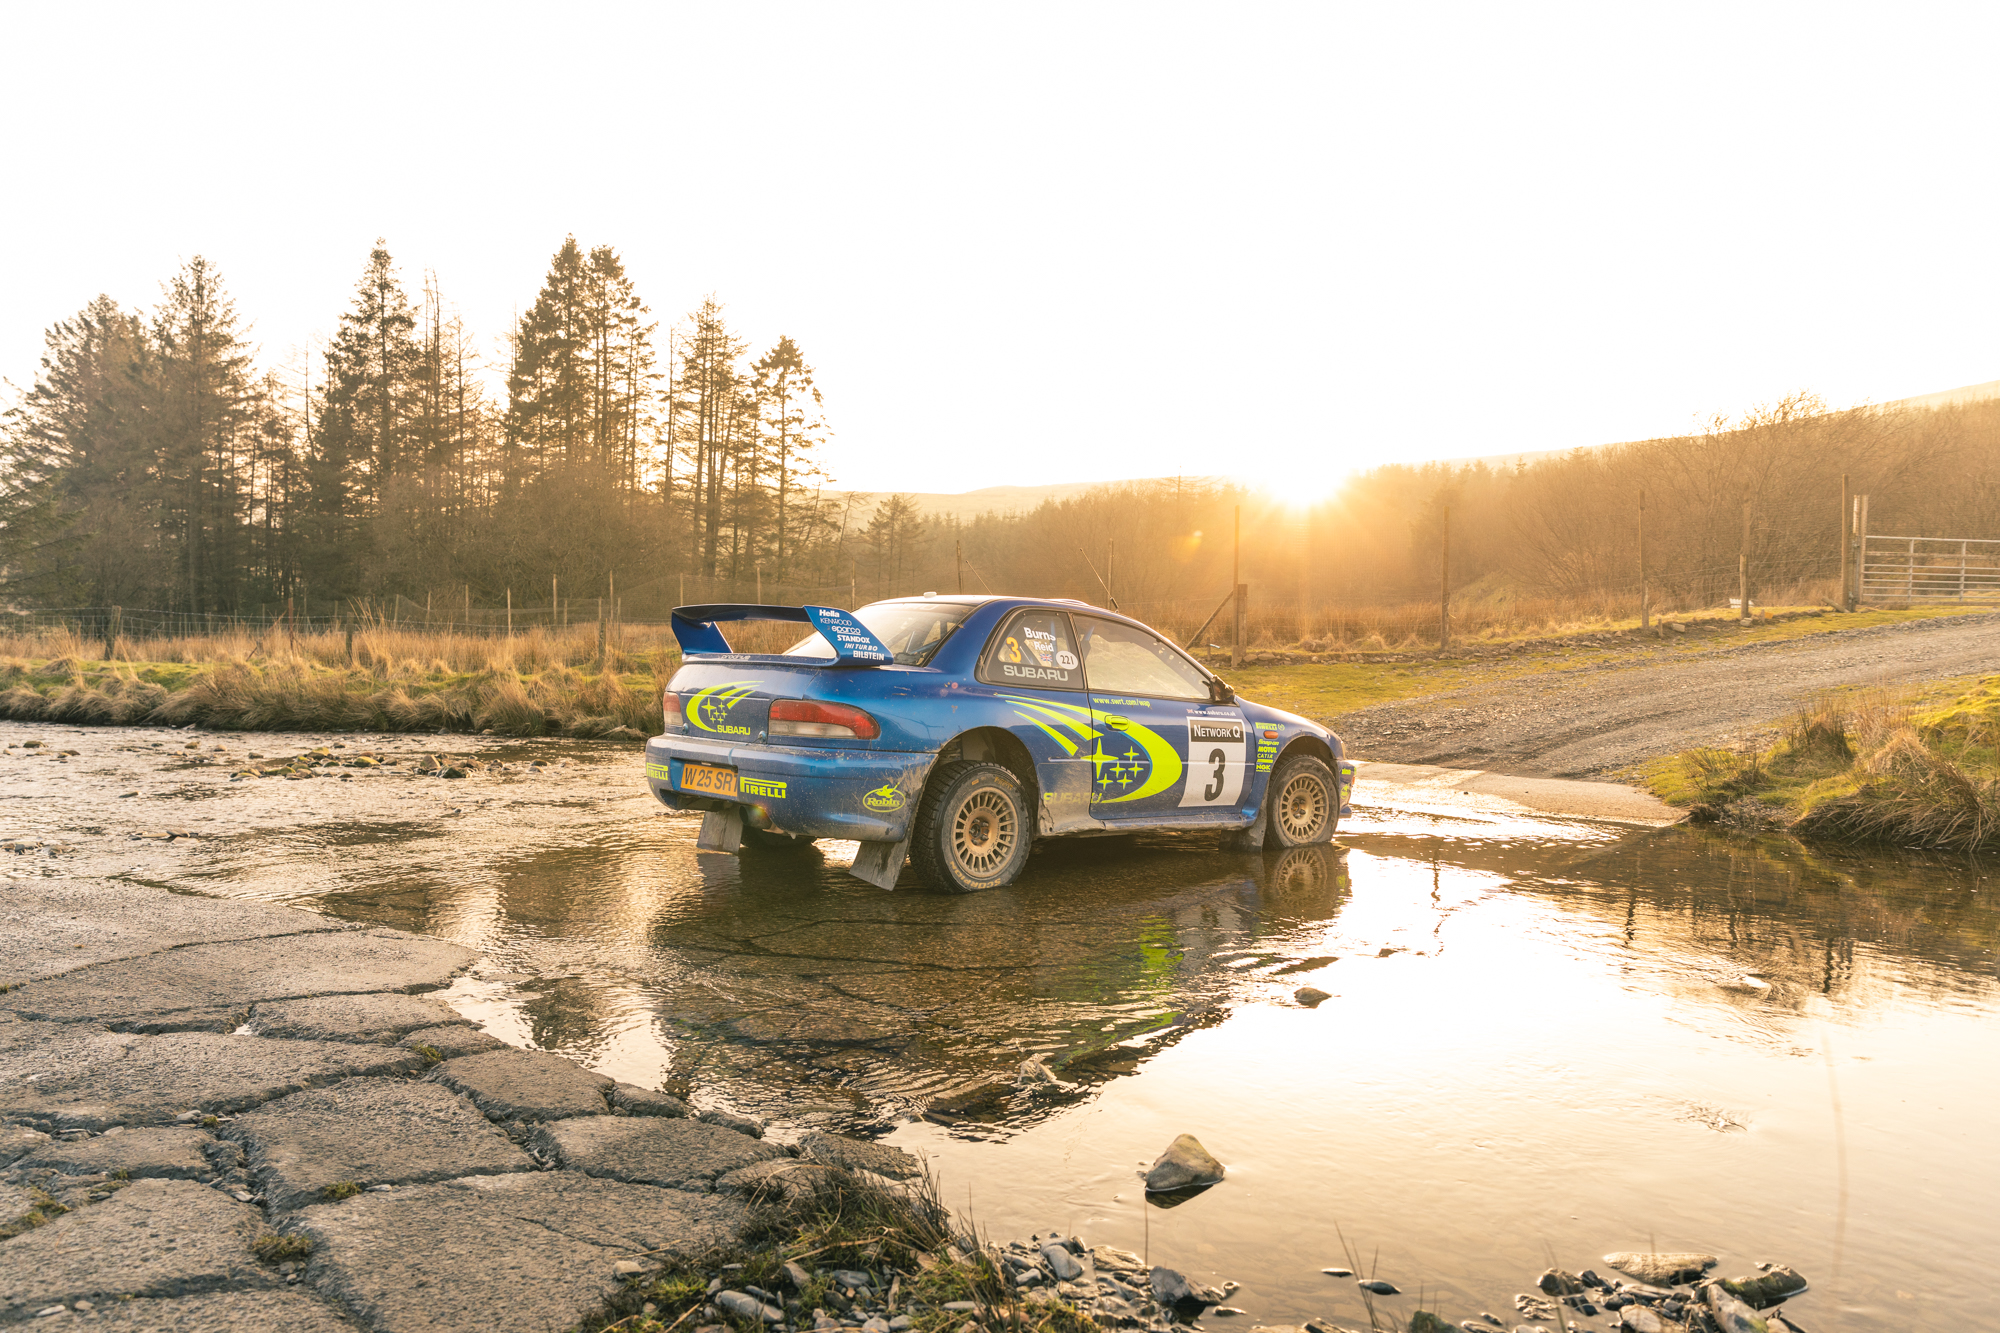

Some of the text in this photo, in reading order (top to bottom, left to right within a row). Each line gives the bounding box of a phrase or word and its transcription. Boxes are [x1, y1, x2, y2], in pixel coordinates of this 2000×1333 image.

[819, 609, 840, 618] Hella
[820, 618, 852, 626] KENWOOD
[837, 635, 870, 644] STANDOX
[1024, 627, 1056, 641] Burns
[855, 644, 878, 652] TURBO
[1006, 636, 1022, 662] 3
[1034, 641, 1054, 652] Reid
[853, 650, 885, 660] BILSTEIN
[1060, 655, 1074, 665] 221
[1004, 665, 1068, 682] SUBARU
[717, 724, 750, 736] SUBARU
[1194, 724, 1240, 738] NETWORK Q
[646, 762, 668, 780] PIRELLI
[1204, 748, 1226, 802] 3
[684, 768, 696, 786] W
[696, 769, 713, 788] 25
[740, 776, 787, 798] PIRELLI
